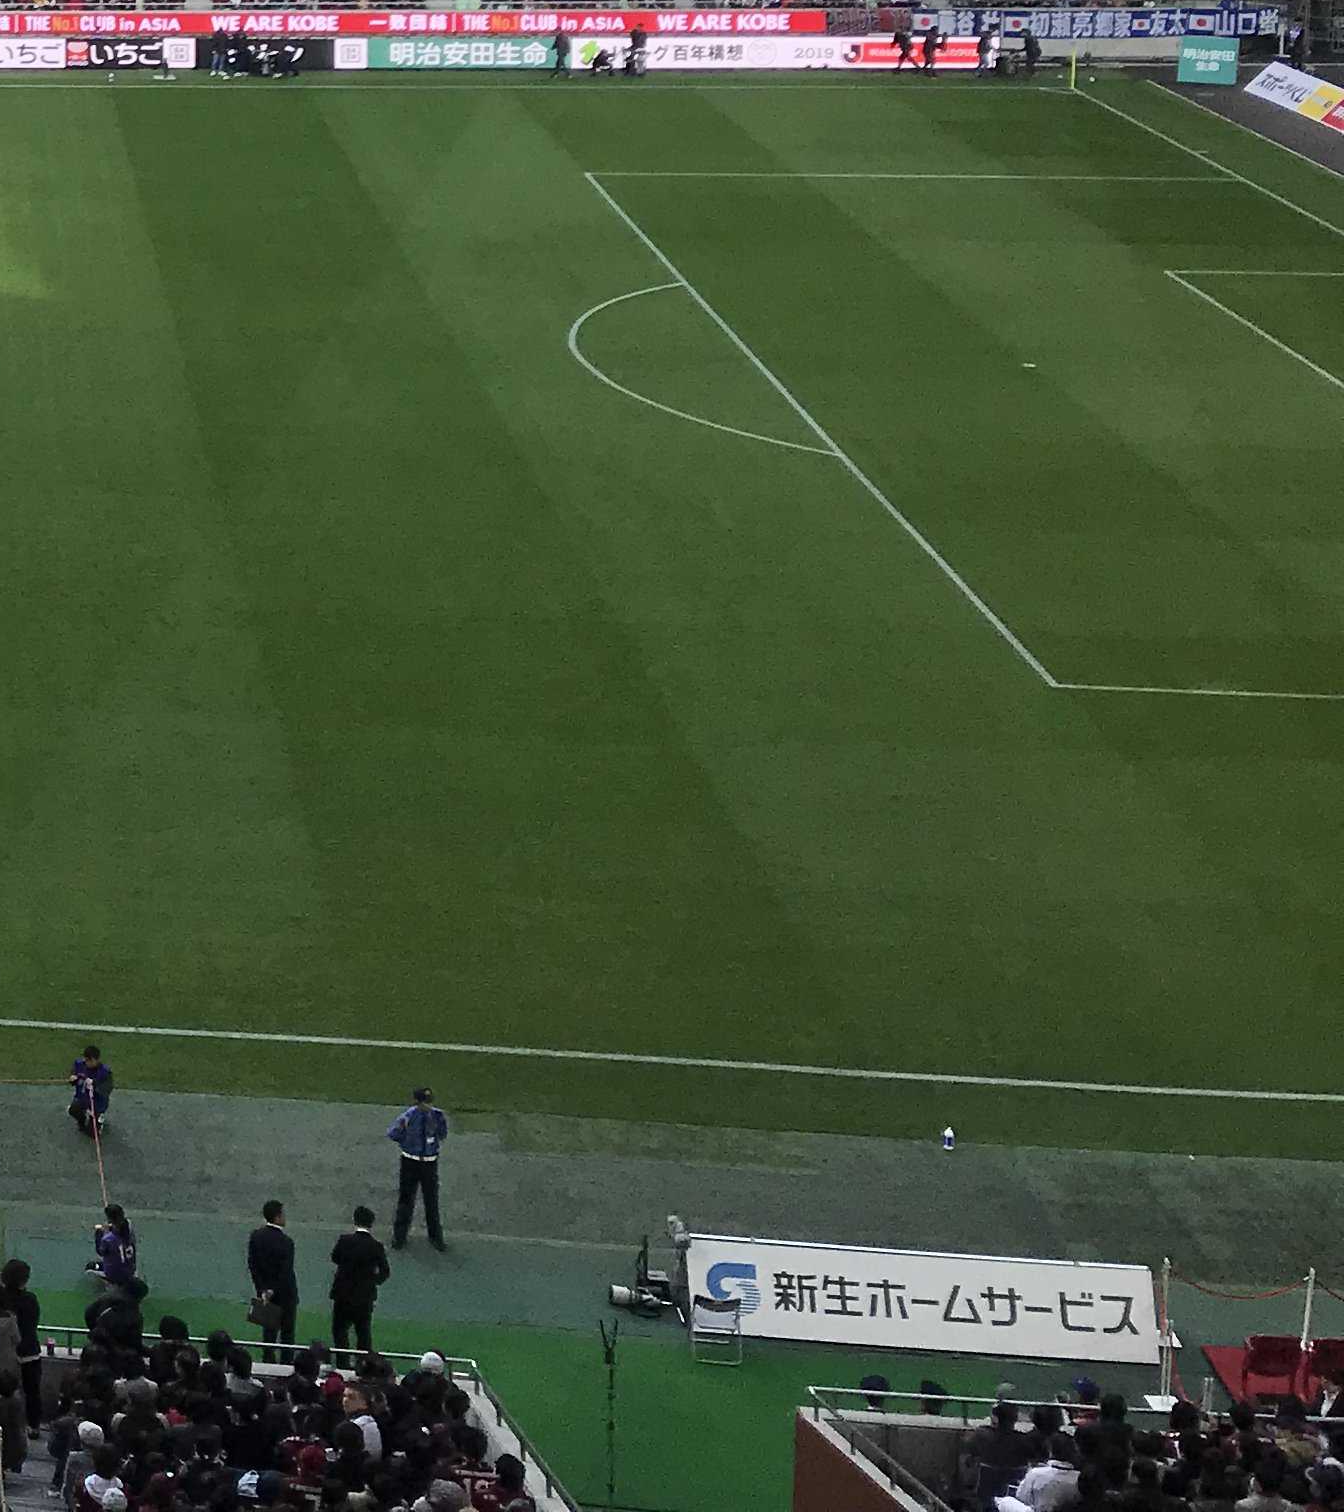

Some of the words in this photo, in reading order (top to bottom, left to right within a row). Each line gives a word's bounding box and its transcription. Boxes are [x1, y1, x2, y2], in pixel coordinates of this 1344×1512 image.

[25, 16, 50, 32] THE
[119, 16, 135, 32] in
[139, 16, 182, 32] ASIA
[211, 16, 240, 32] WE
[246, 16, 285, 32] ARE
[288, 16, 340, 32] KOBE
[462, 15, 490, 31] THE
[521, 15, 558, 31] CLUB
[562, 15, 578, 31] in
[581, 15, 625, 31] ASIA
[657, 15, 688, 31] WE
[690, 15, 732, 31] ARE
[737, 15, 791, 31] KOBE
[90, 42, 163, 65] いちご
[390, 42, 548, 65] 明治安田生命
[794, 46, 835, 59] 2019
[772, 1269, 1139, 1337] 新生ホームサービス
